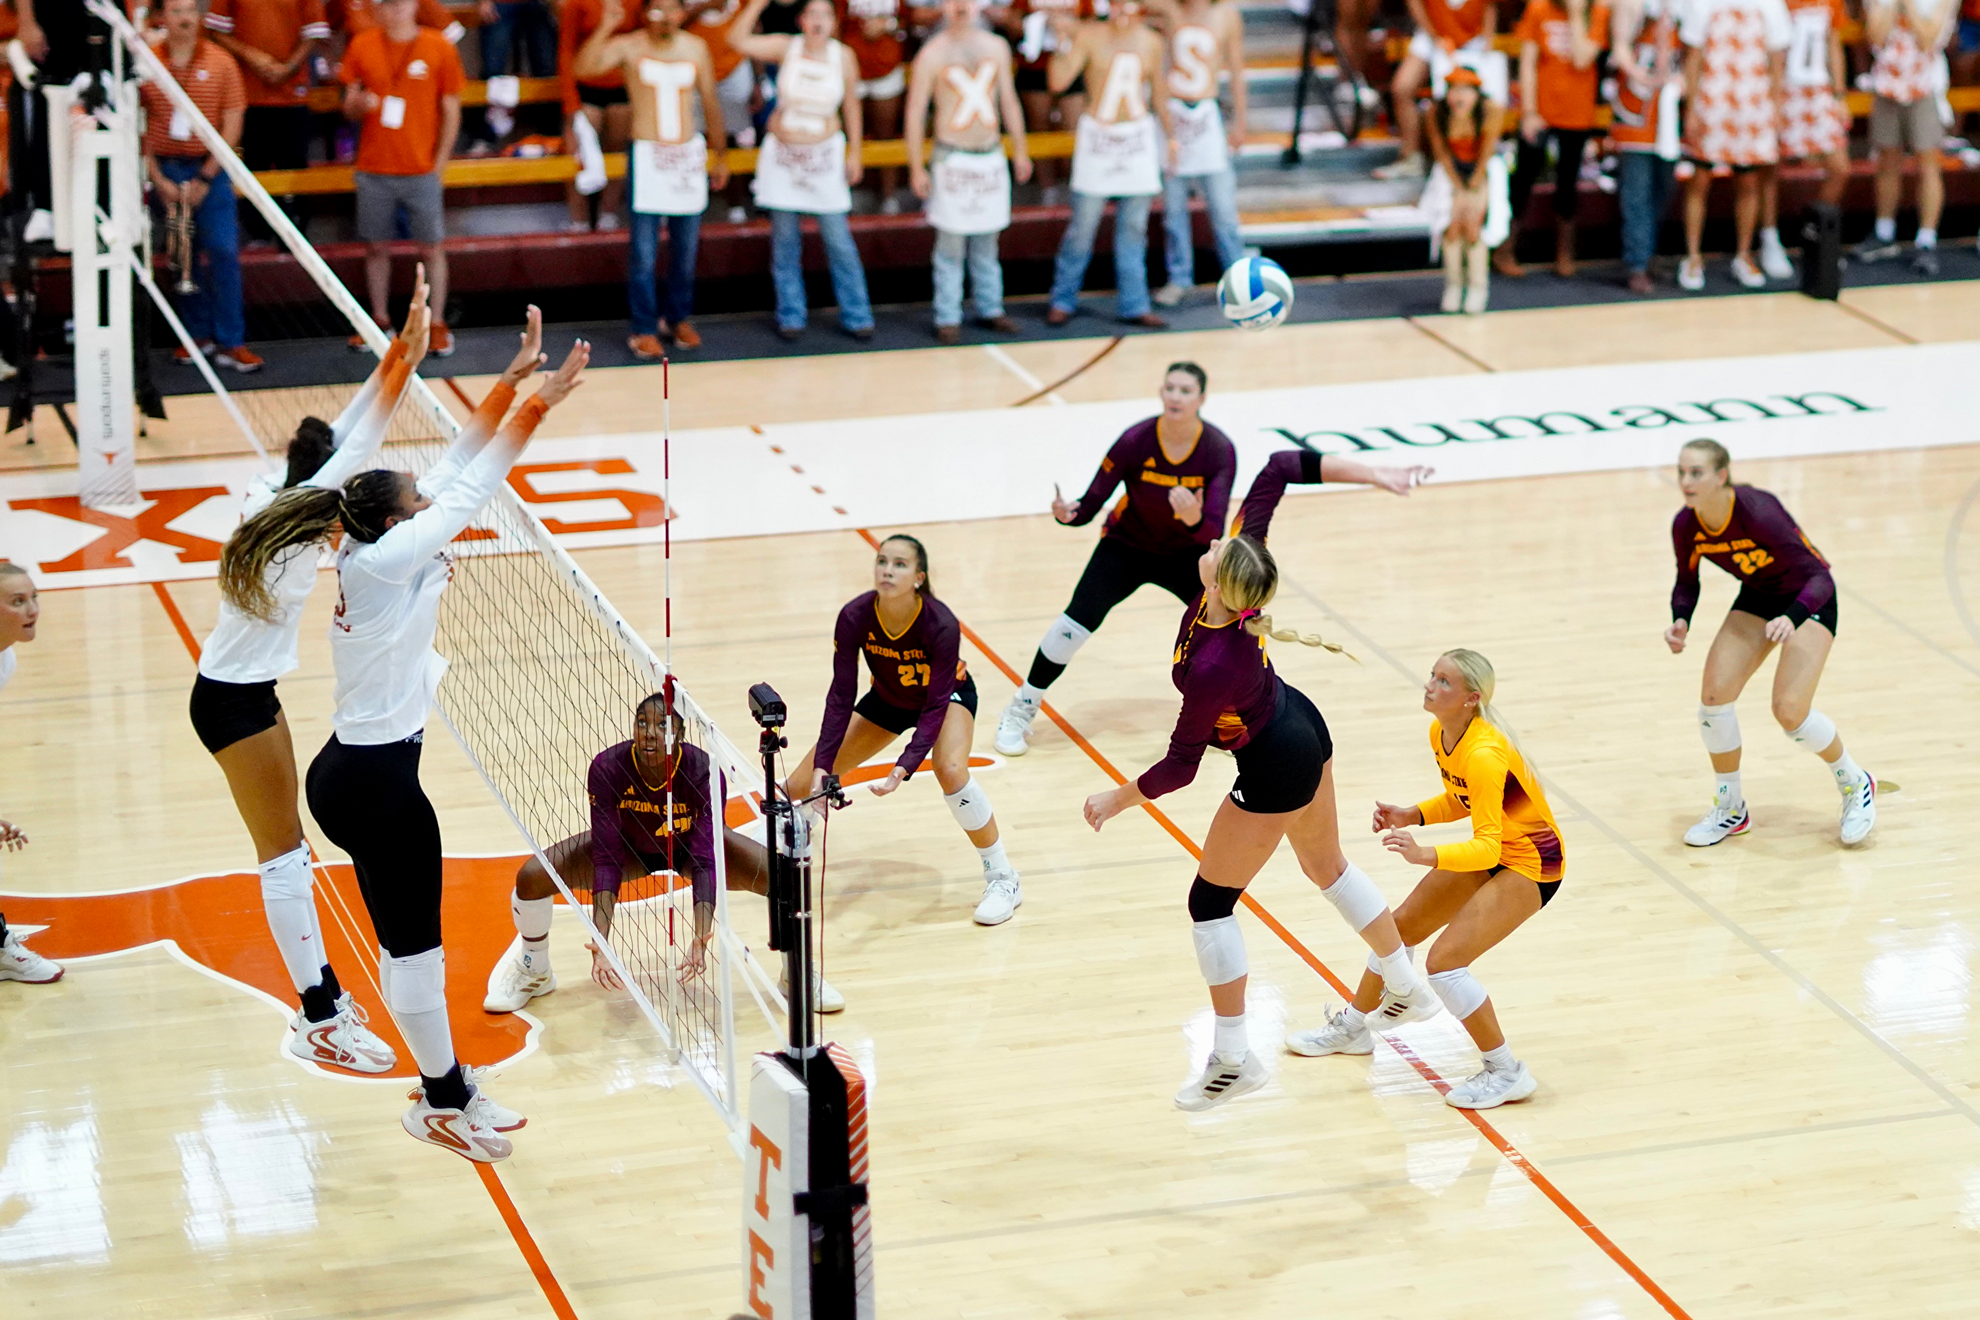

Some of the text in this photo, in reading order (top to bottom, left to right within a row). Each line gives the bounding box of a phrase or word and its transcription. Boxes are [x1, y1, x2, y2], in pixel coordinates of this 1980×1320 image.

[1259, 391, 1888, 456] humann
[1732, 548, 1775, 575] 22
[897, 662, 931, 688] 27
